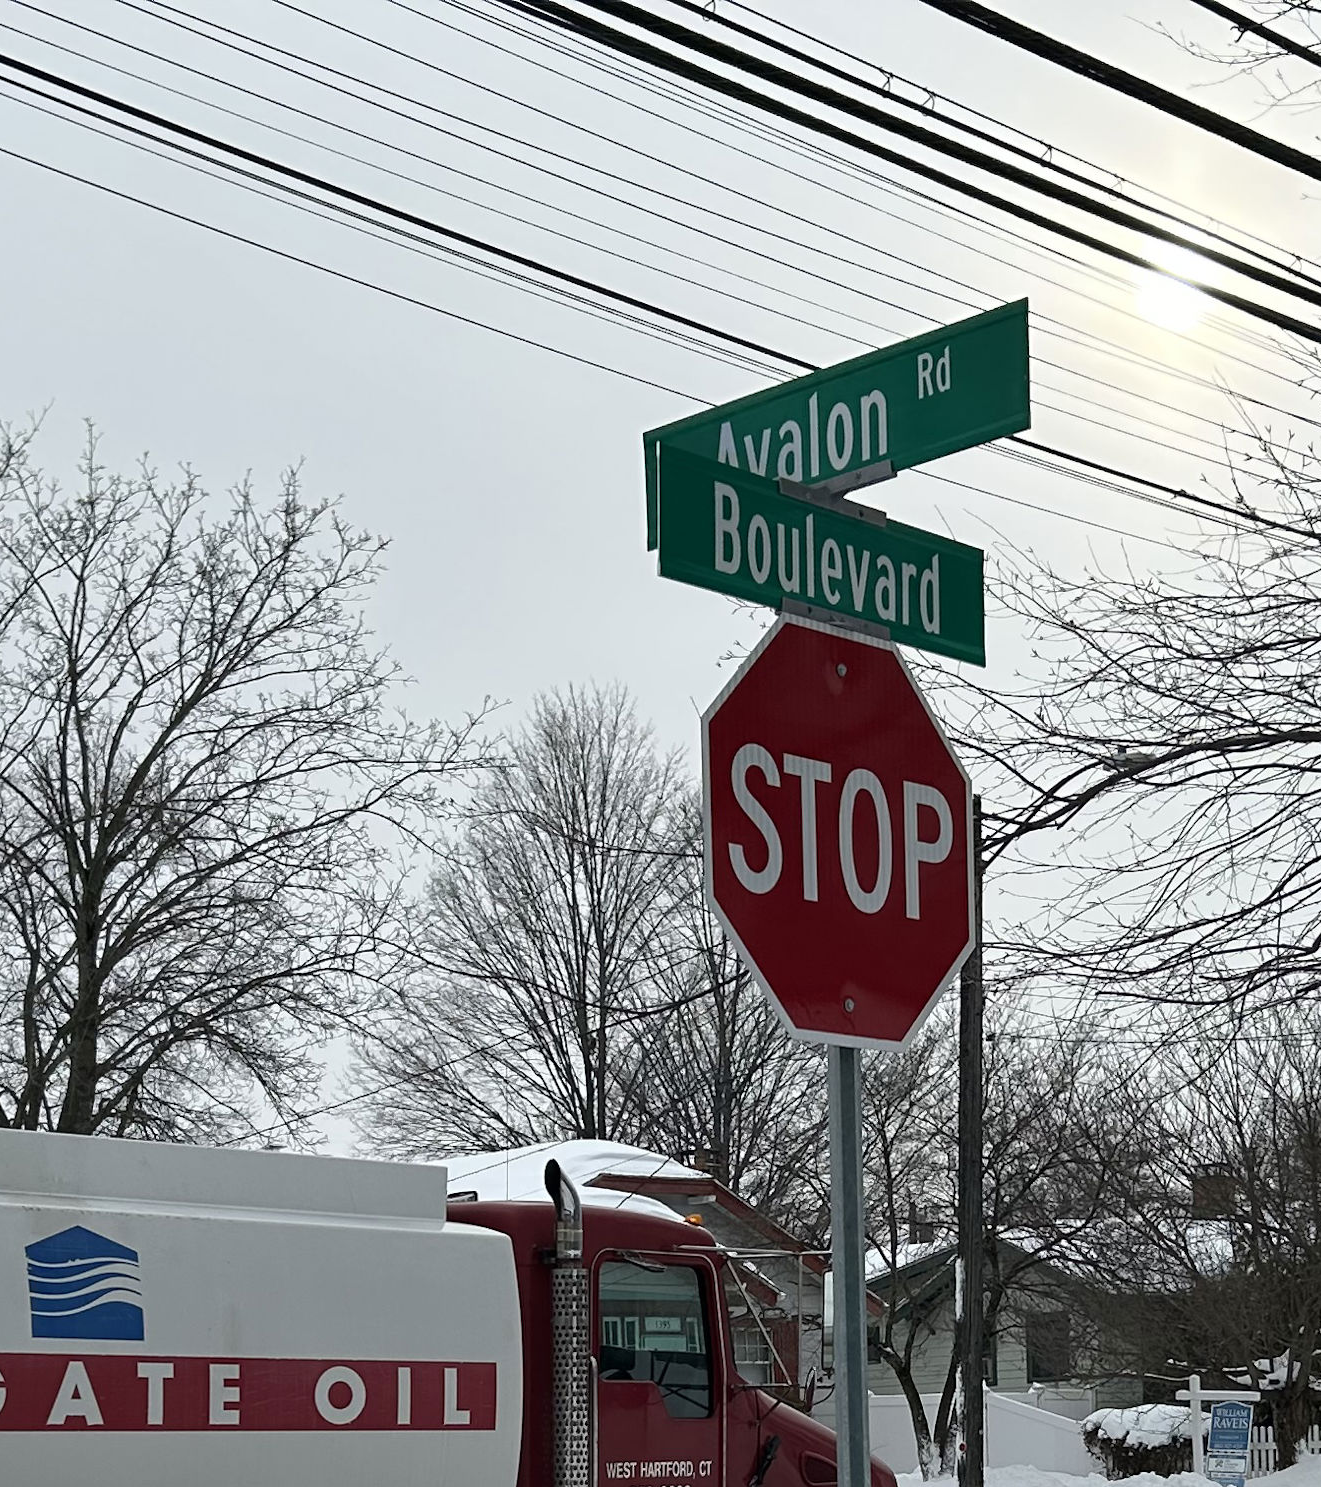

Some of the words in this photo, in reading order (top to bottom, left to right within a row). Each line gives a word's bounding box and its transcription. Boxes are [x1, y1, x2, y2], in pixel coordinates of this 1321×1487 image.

[717, 388, 888, 484] Avalon
[916, 346, 953, 400] Rd
[714, 481, 942, 636] Boulevard
[728, 743, 955, 920] STOP
[314, 1364, 471, 1425] OIL
[1214, 1417, 1248, 1429] RAVEIS
[606, 1461, 638, 1479] WEST
[640, 1461, 696, 1479] HARTFORD,
[698, 1460, 713, 1477] CT
